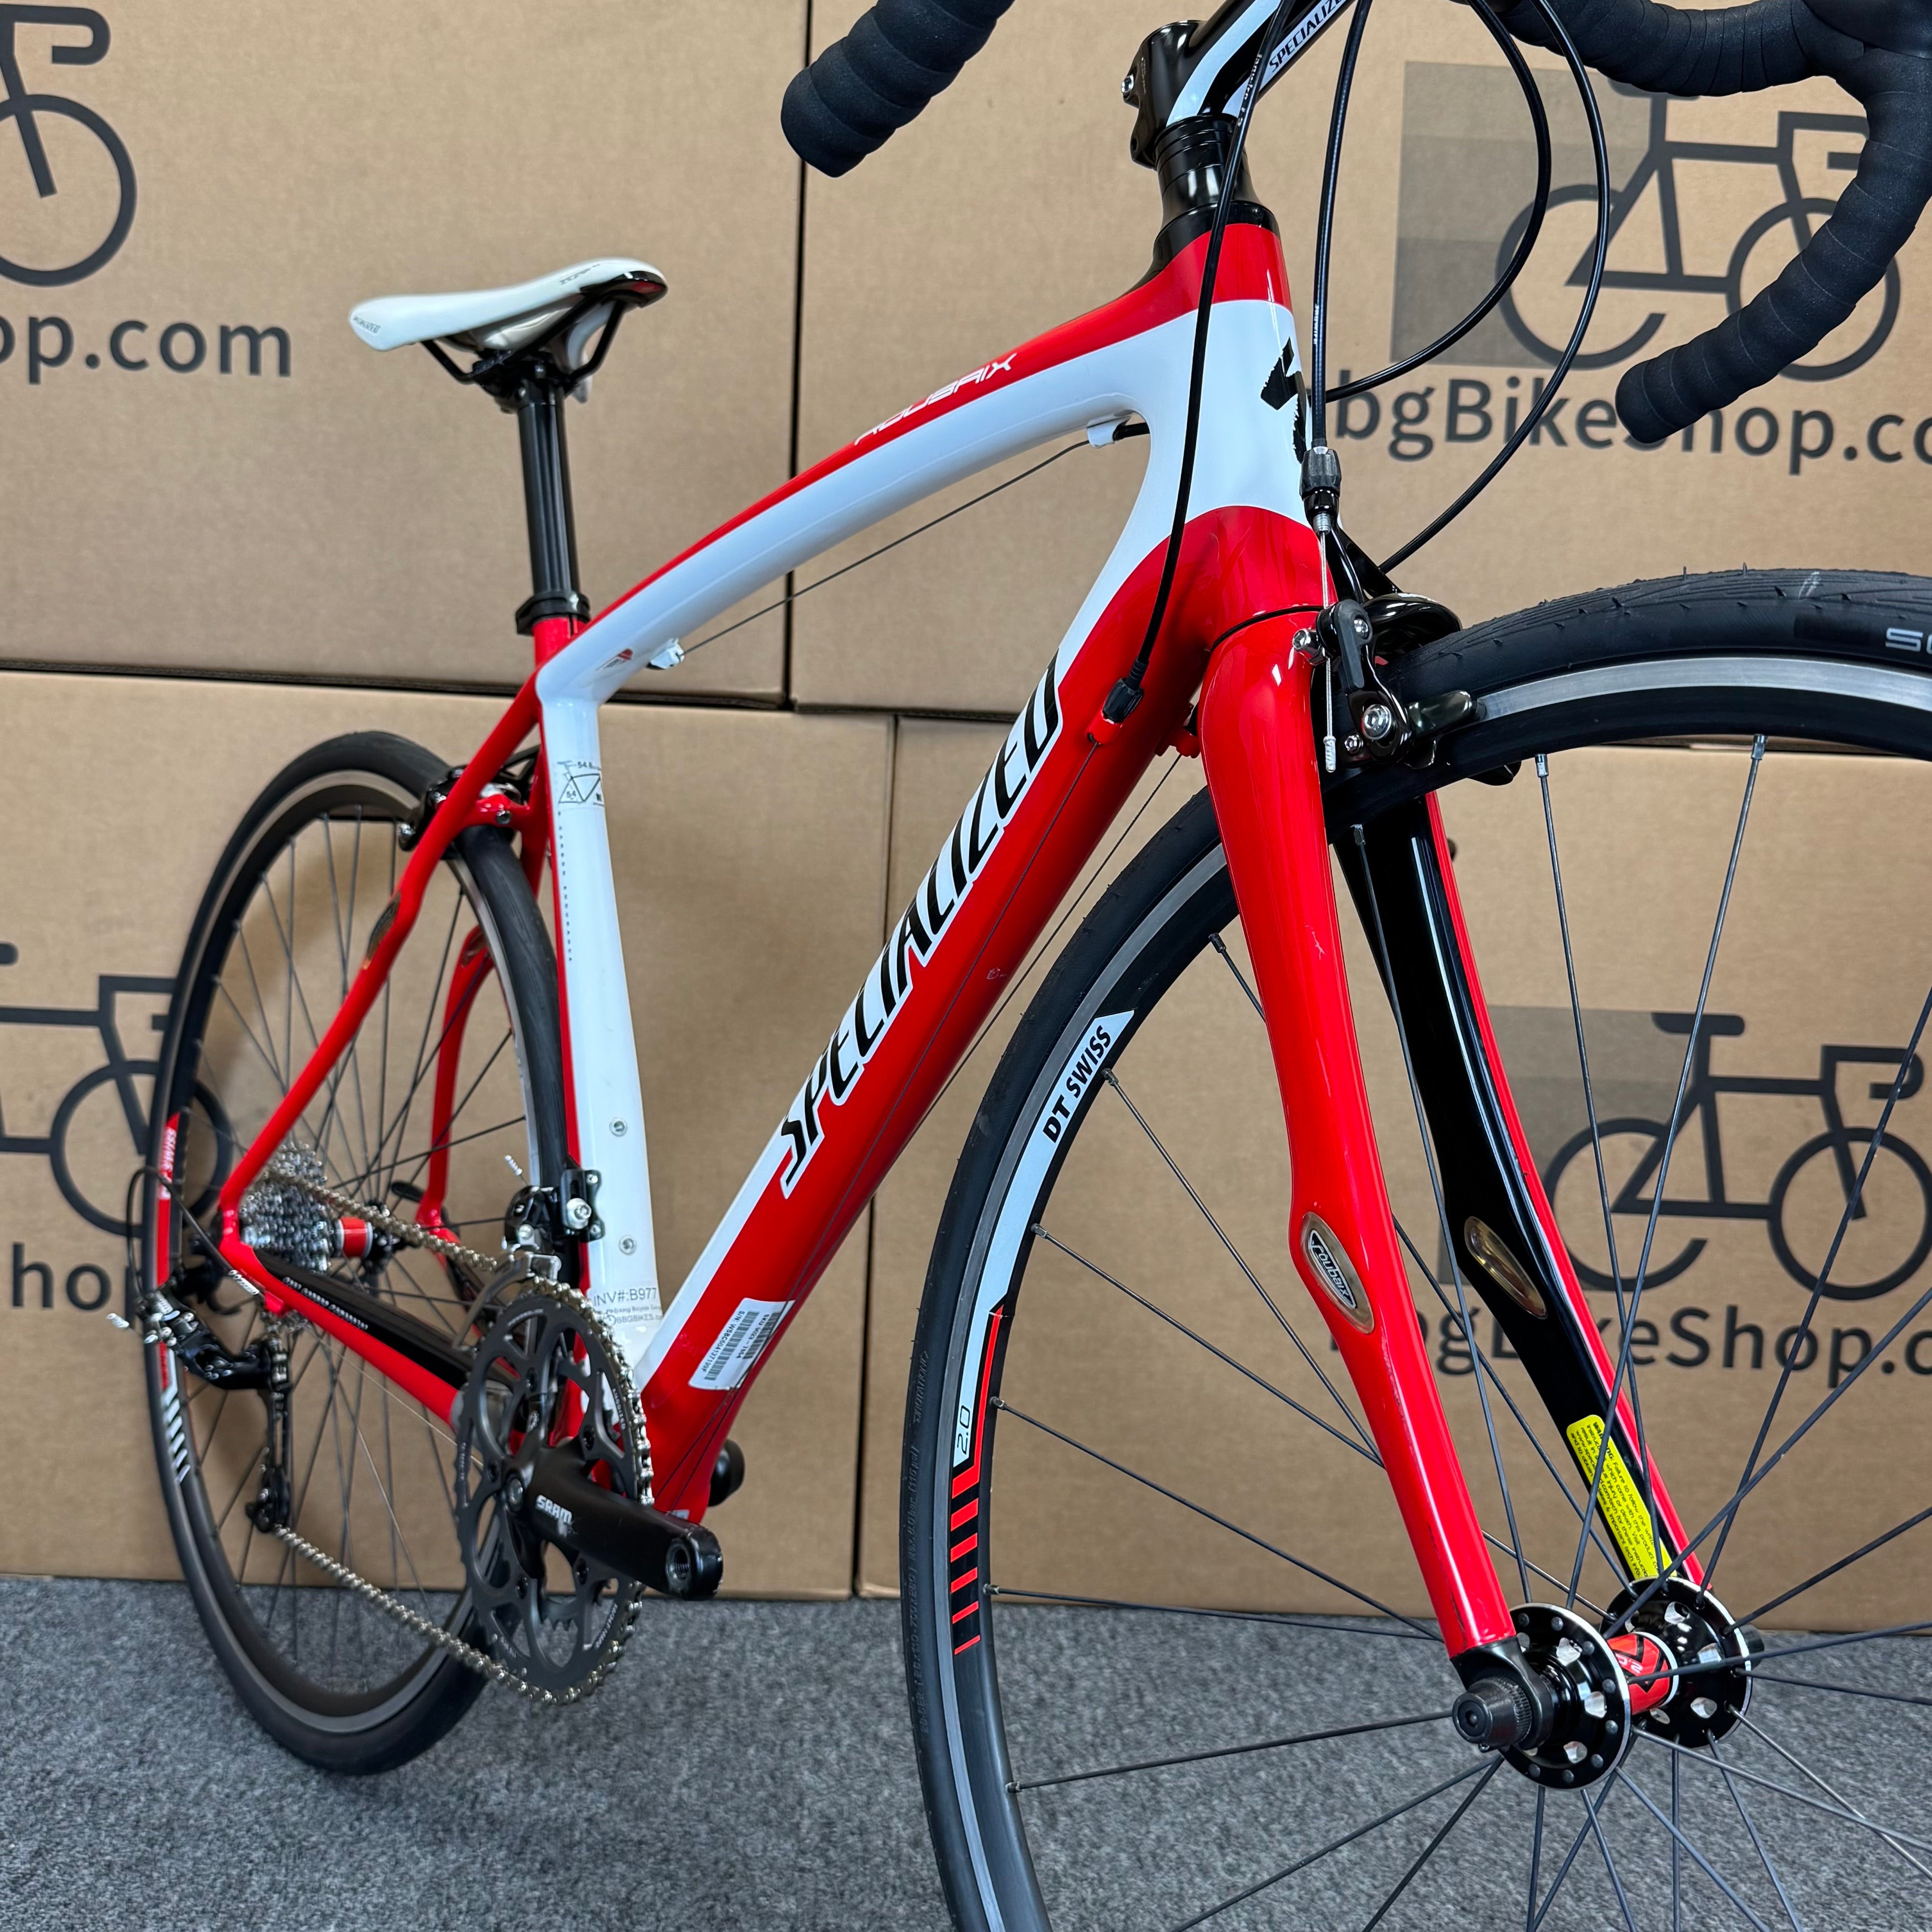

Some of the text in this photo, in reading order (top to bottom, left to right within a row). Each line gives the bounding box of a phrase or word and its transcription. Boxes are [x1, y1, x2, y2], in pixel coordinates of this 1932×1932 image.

[1885, 627, 1932, 654] S
[781, 648, 1060, 1189] SPECIALIZED
[1042, 1026, 1111, 1142] DT SWISS
[12, 1241, 140, 1329] ho
[957, 1405, 971, 1455] 2.0
[536, 1495, 572, 1524] SRAM
